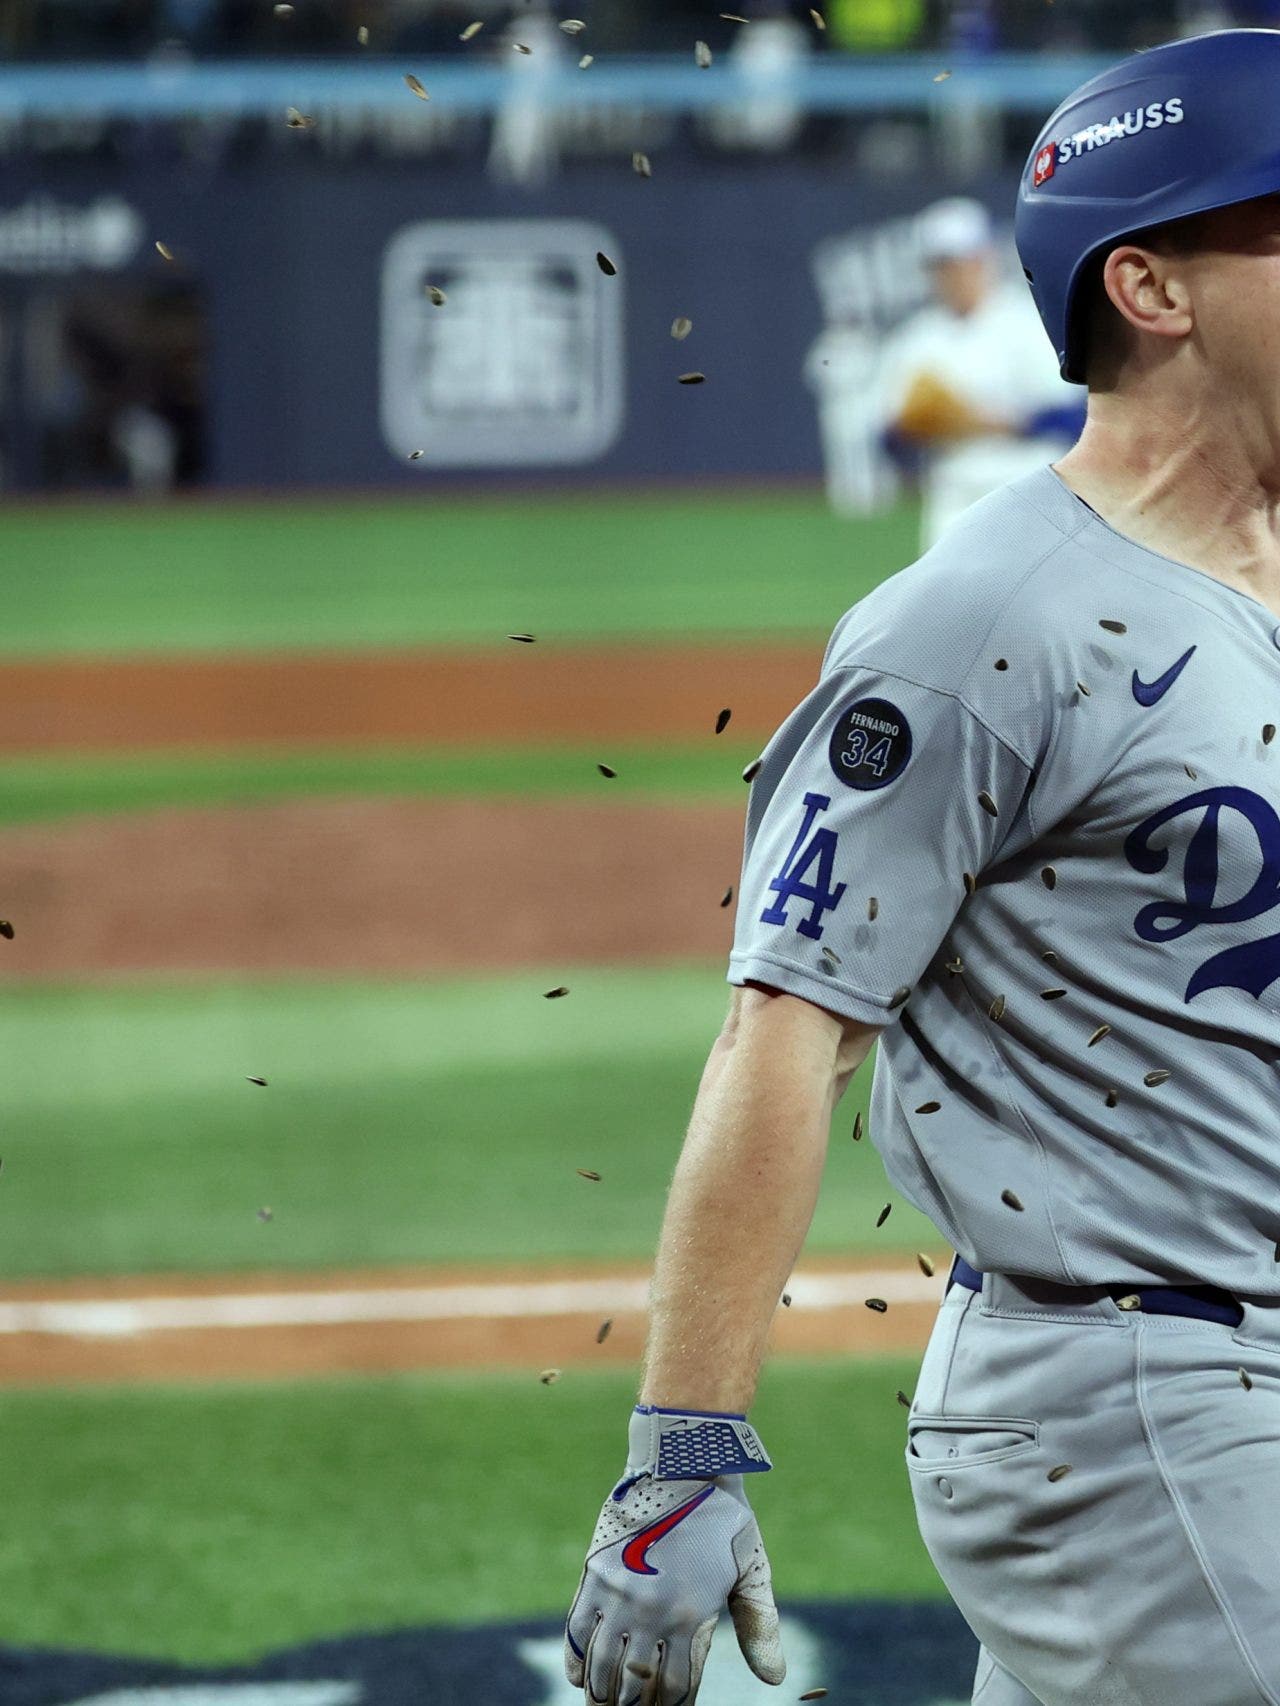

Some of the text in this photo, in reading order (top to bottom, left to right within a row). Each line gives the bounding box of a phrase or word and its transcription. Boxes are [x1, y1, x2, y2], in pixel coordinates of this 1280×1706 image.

[1058, 97, 1184, 164] STRAUSS
[840, 729, 893, 777] 34
[849, 711, 900, 738] FERNANDO
[760, 791, 847, 941] LA
